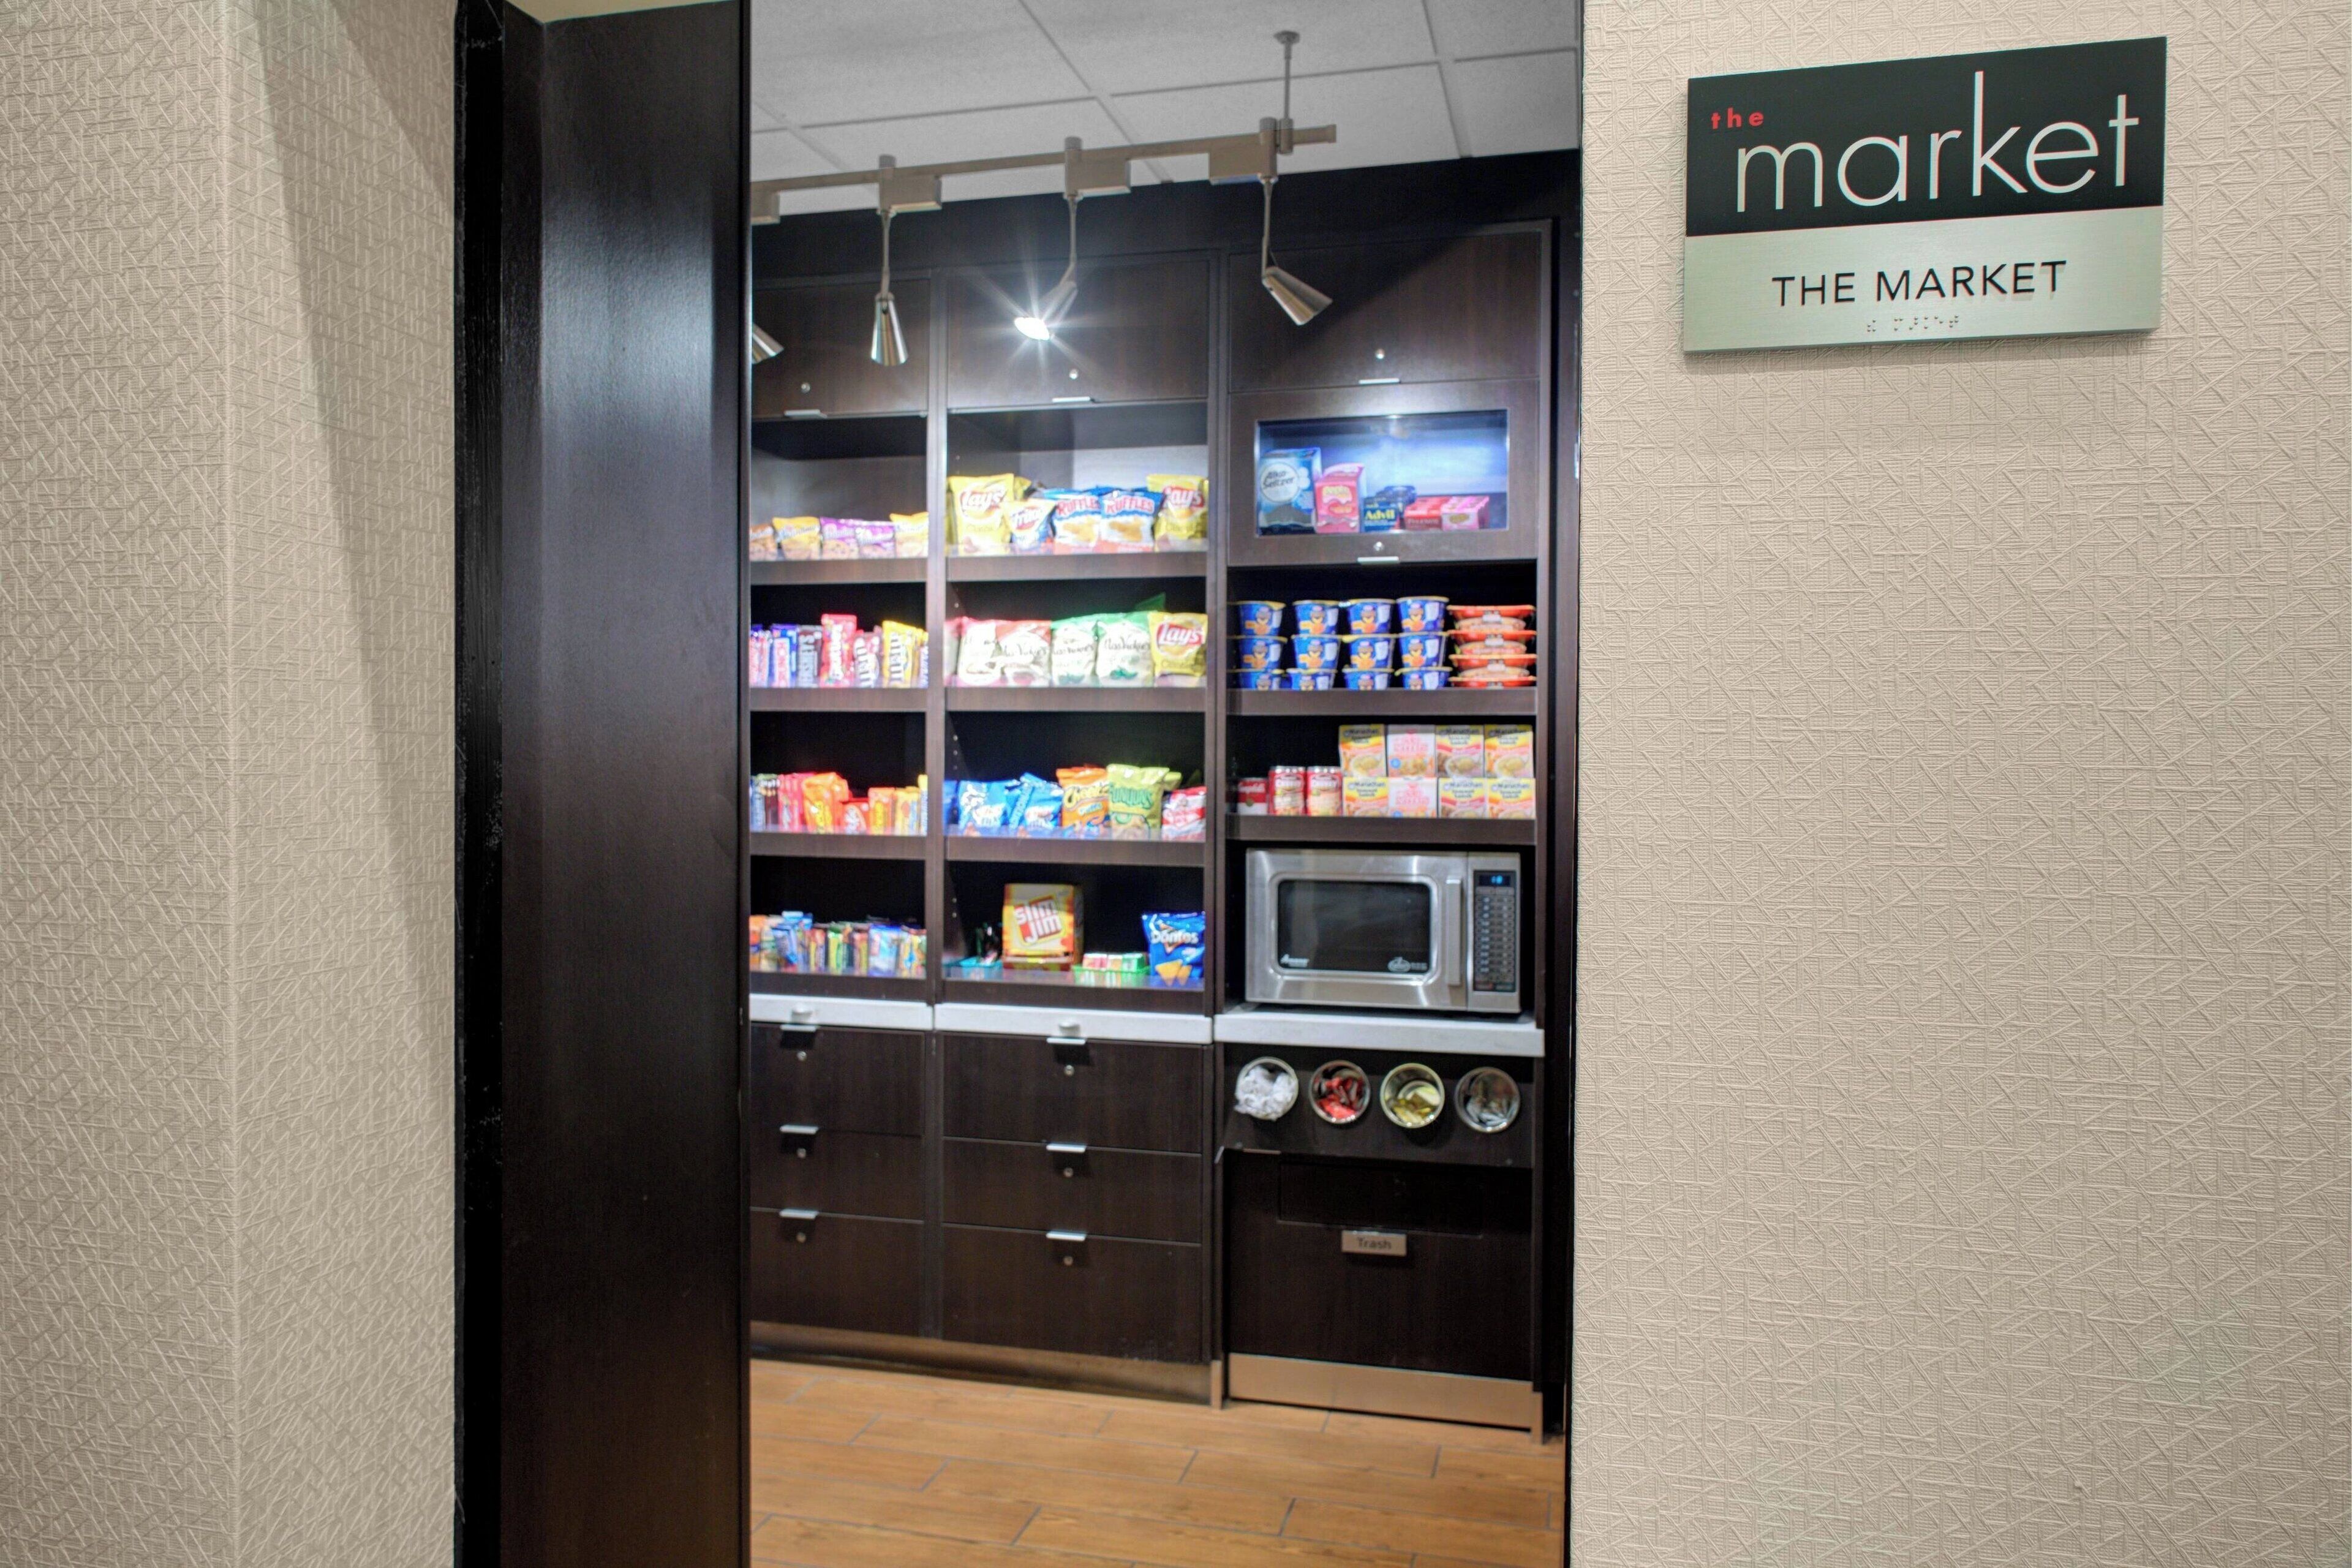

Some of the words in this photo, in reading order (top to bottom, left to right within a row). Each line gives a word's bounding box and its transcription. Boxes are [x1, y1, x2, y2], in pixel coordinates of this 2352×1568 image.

[1711, 108, 1764, 129] the
[1737, 70, 2139, 213] market
[1772, 271, 1855, 307] THE
[1876, 260, 2067, 301] MARKET
[1365, 509, 1395, 520] Advil
[1150, 929, 1199, 944] Doritos
[1357, 1237, 1392, 1250] Trash
